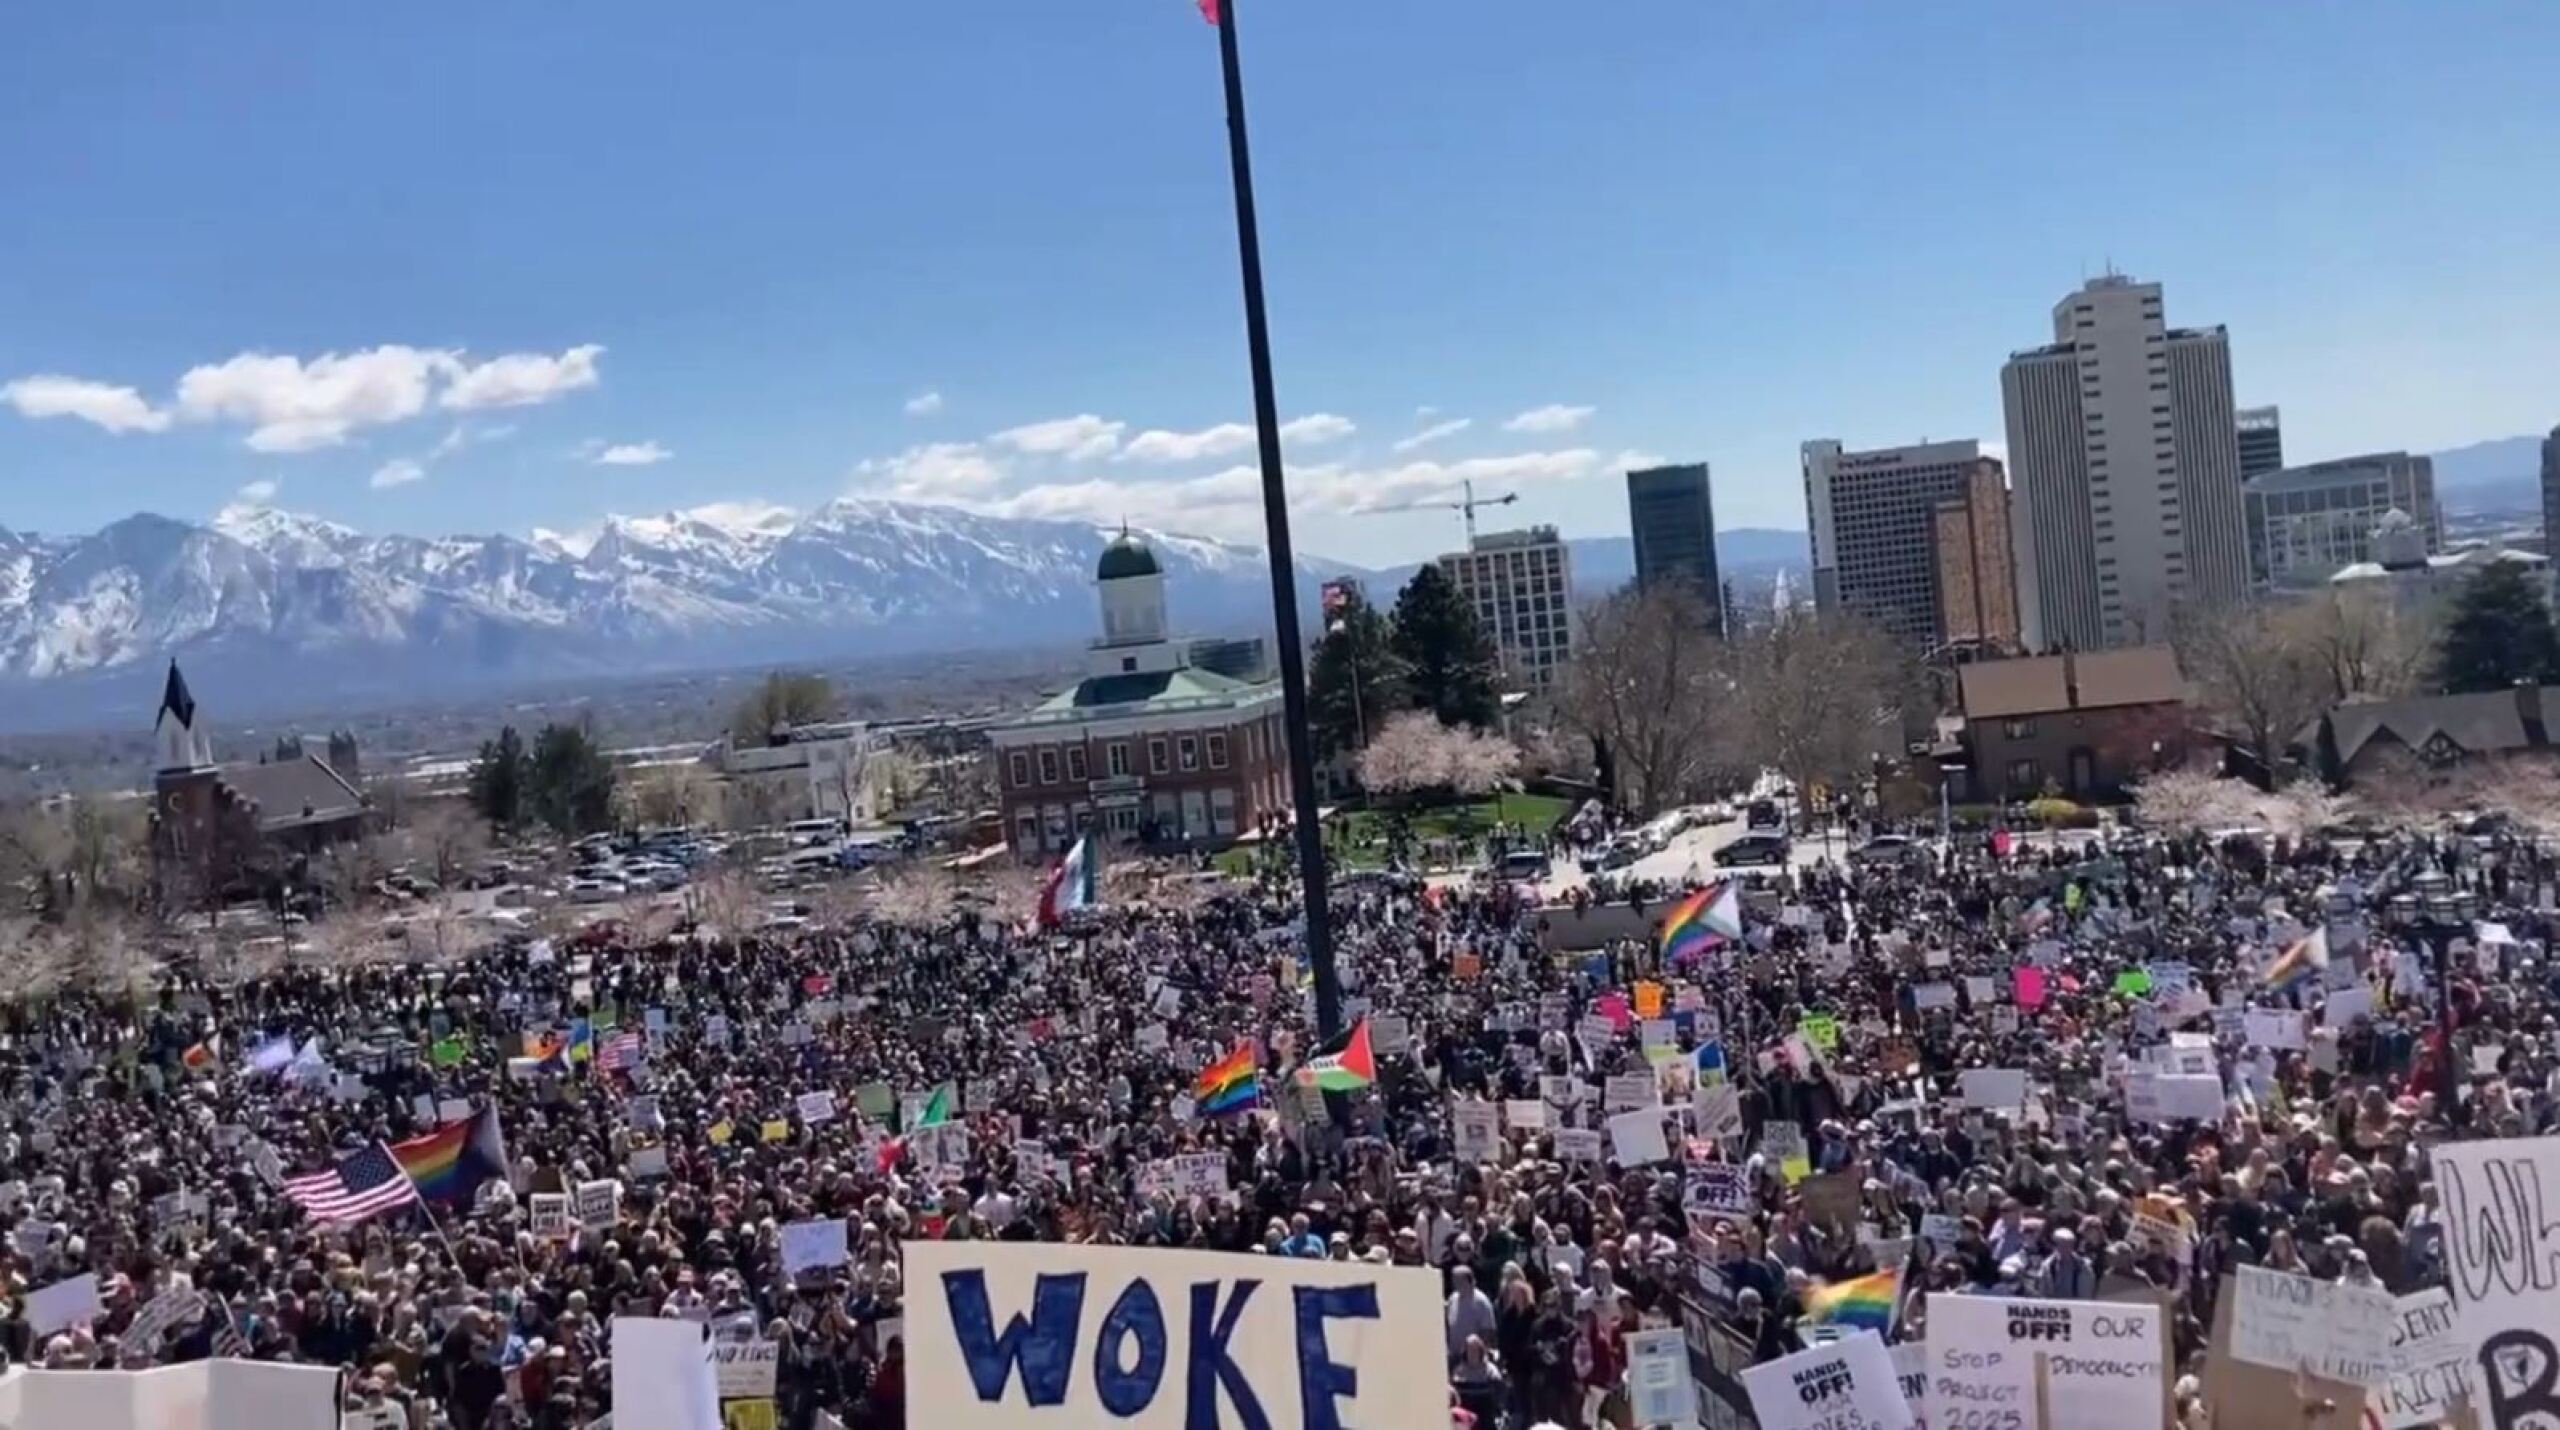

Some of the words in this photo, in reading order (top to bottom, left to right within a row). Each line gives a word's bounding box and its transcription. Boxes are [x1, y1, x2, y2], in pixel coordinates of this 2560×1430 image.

[2007, 1305, 2071, 1320] HANDS
[2007, 1320, 2072, 1342] OFF!
[2091, 1315, 2145, 1338] OUR
[941, 1268, 1382, 1430] WOKE
[1943, 1348, 2002, 1370] STOP
[1792, 1357, 1848, 1386] HANDS
[1799, 1371, 1856, 1404] OFF!
[1936, 1377, 2020, 1402] PROJECT
[1944, 1408, 2022, 1430] 2025
